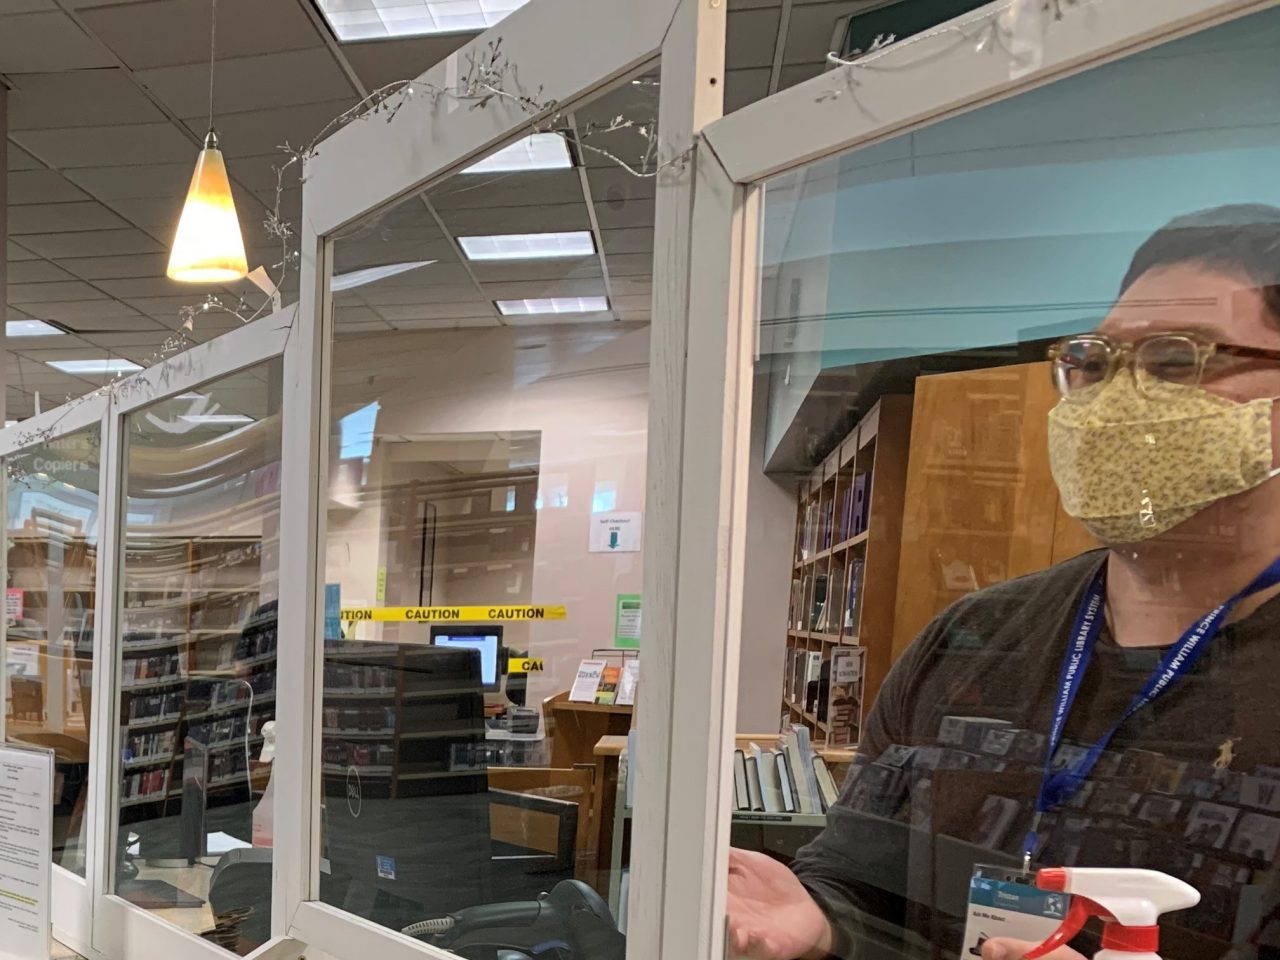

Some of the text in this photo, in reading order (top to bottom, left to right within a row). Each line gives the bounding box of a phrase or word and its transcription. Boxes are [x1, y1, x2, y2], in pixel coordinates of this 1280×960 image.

[340, 608, 544, 620] UTION CAUTION CAUTION
[1058, 680, 1072, 716] WILLIAM
[1066, 653, 1082, 680] PUBLIC
[1074, 621, 1092, 652] LIBRARY
[1084, 593, 1101, 621] SYSTEM
[1169, 634, 1201, 670] WILLIAM
[1148, 669, 1175, 698] PUBLIC
